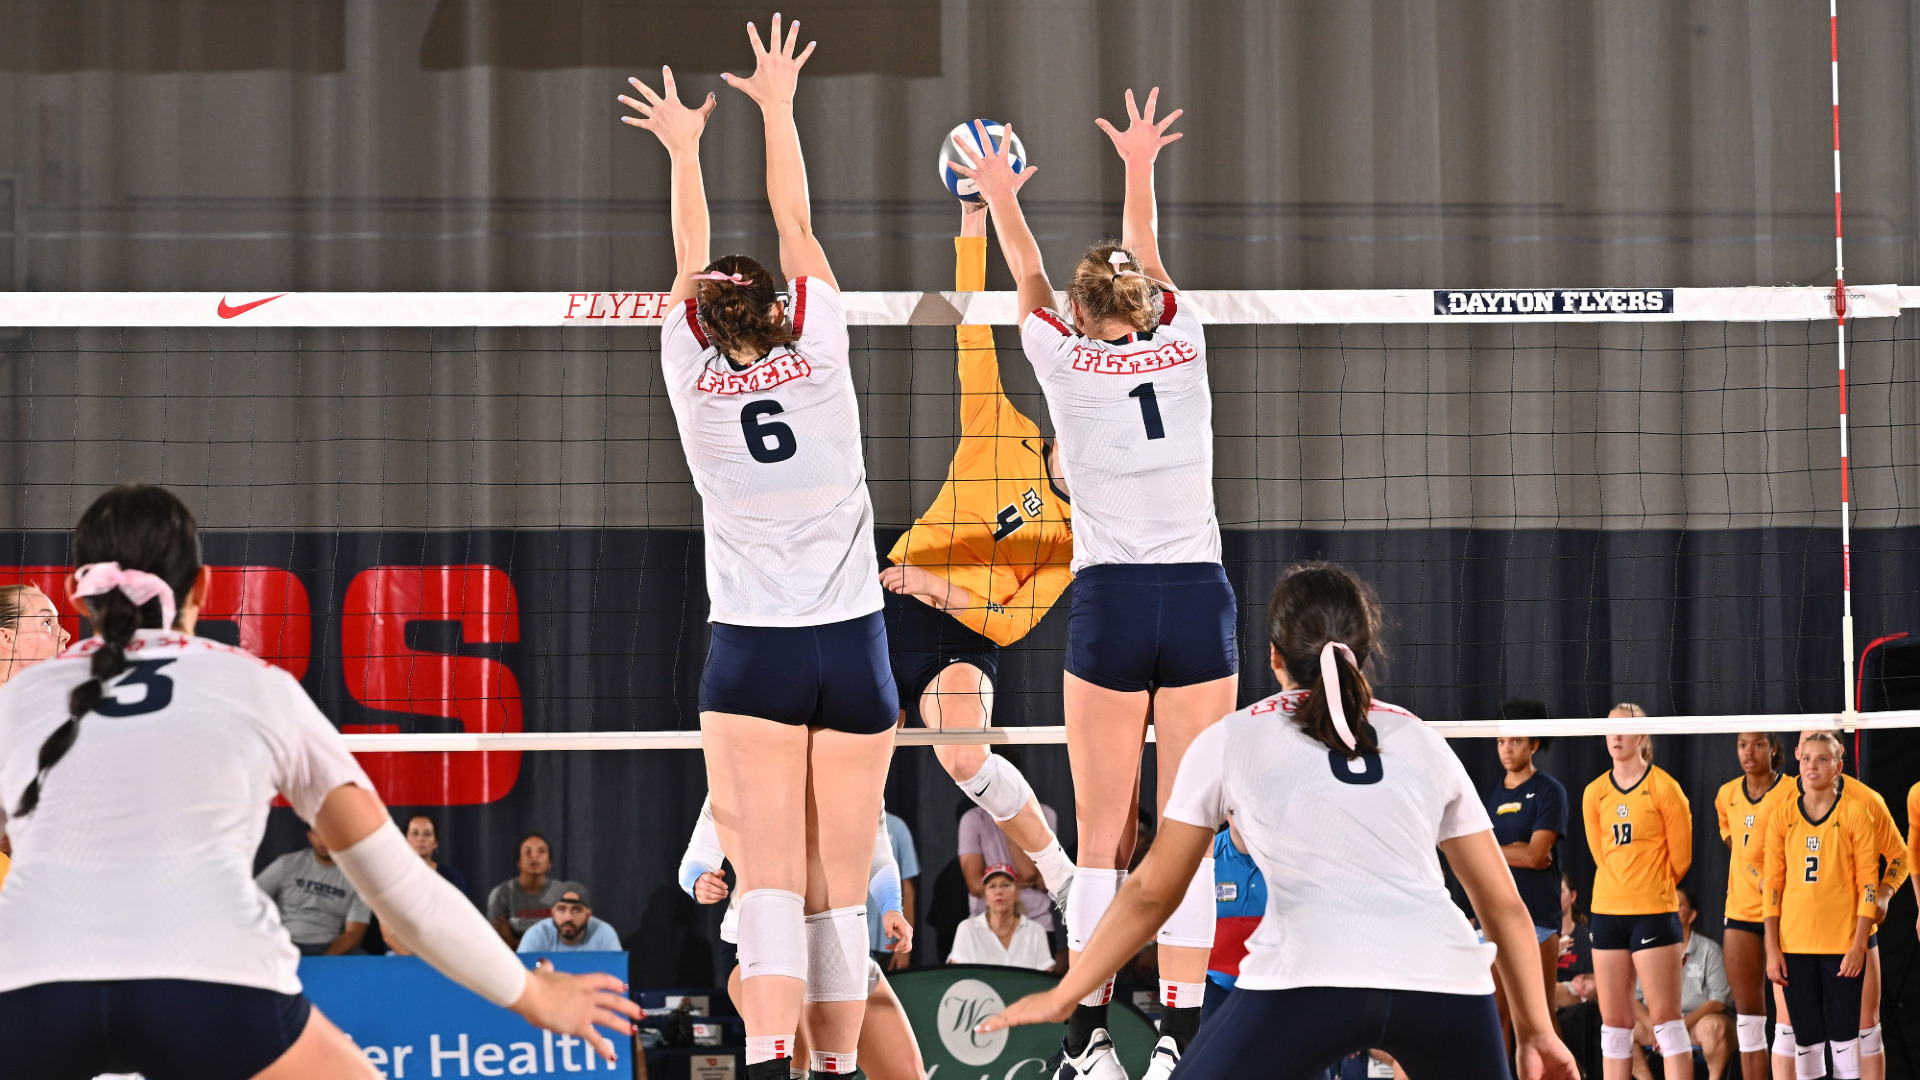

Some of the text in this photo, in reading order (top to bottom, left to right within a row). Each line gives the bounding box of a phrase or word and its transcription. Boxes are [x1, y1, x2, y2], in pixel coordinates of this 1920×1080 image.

[1448, 291, 1664, 313] DAYTON FLYERS
[1071, 340, 1198, 374] FLYERS
[740, 399, 797, 464] 6
[1129, 382, 1165, 440] 1
[992, 502, 1026, 543] 4
[94, 657, 178, 718] 3
[1612, 822, 1632, 846] 18
[1805, 856, 1819, 883] 2
[430, 1029, 617, 1078] Health
